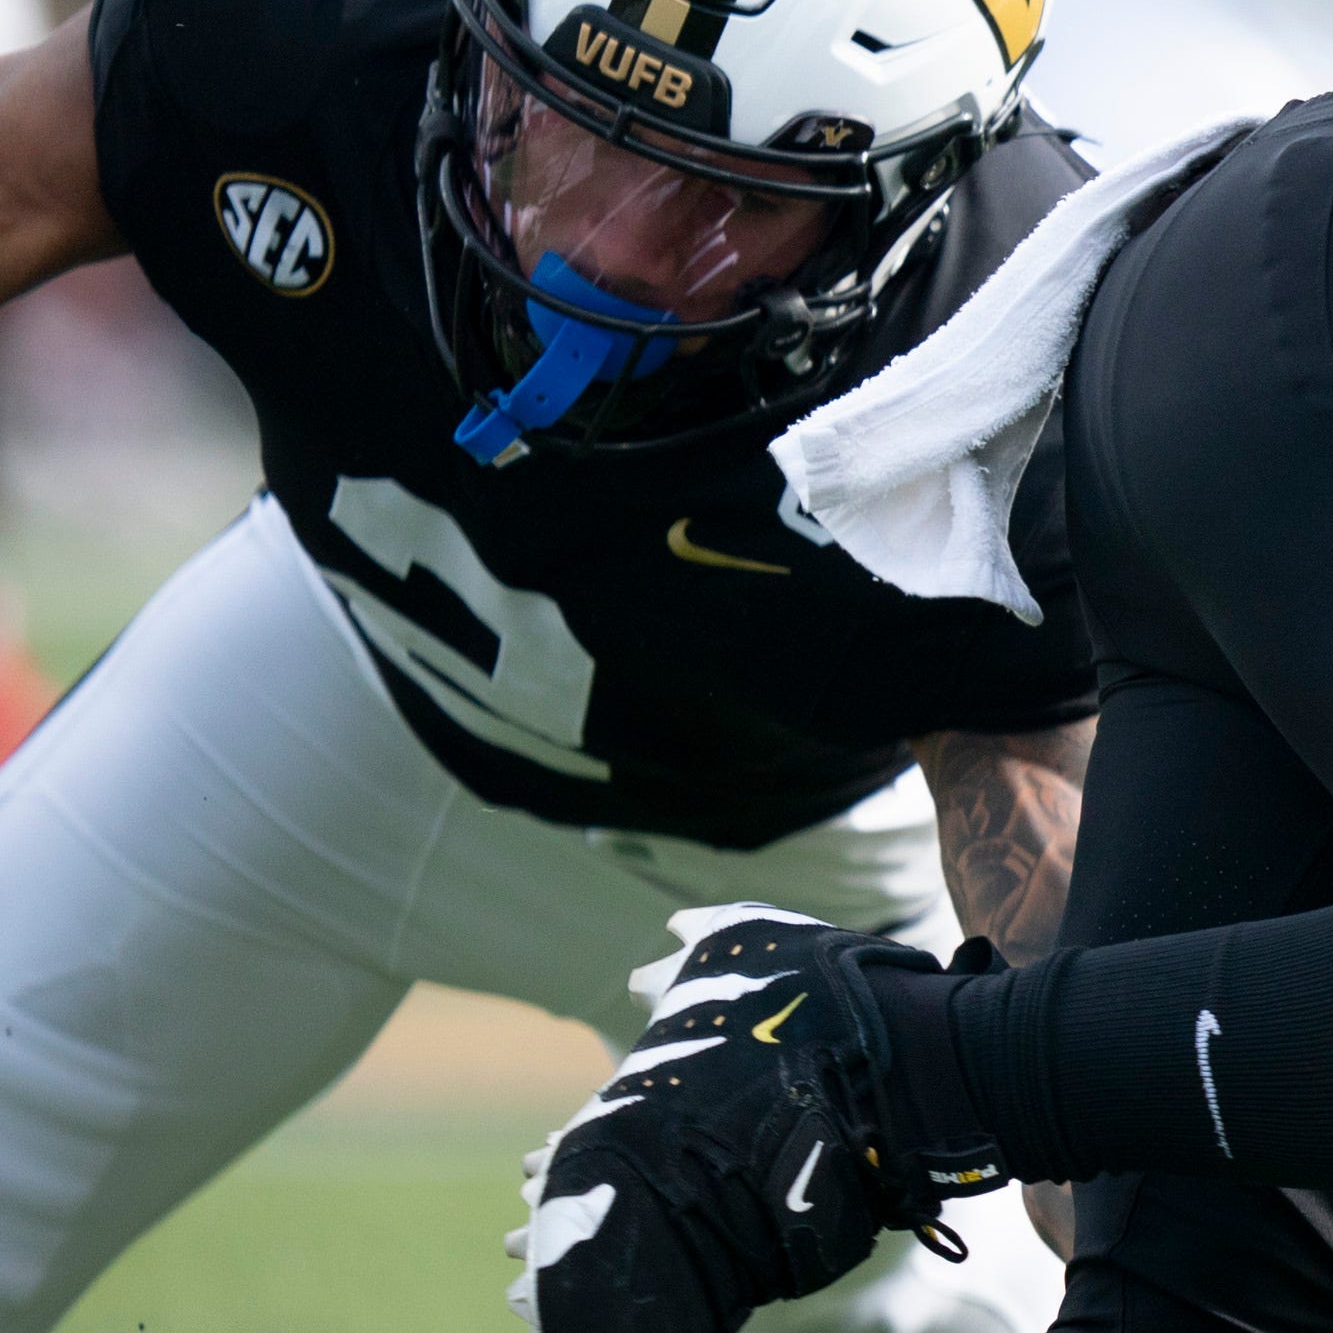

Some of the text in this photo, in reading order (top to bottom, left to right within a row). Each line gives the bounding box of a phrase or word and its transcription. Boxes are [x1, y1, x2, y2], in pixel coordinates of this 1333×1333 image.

[575, 21, 694, 110] VUFB
[222, 181, 326, 288] SEC
[318, 474, 612, 782] 2
